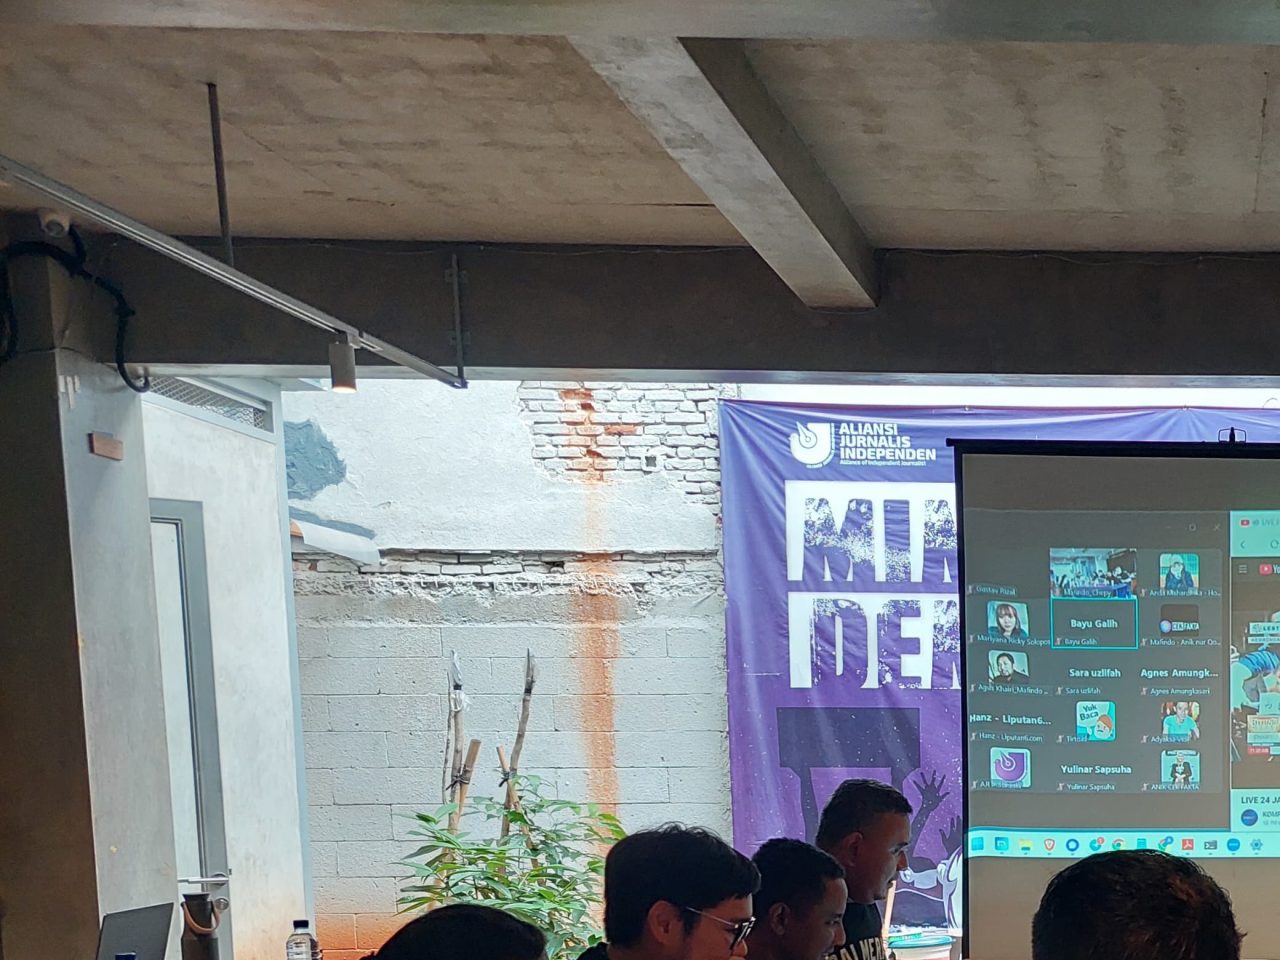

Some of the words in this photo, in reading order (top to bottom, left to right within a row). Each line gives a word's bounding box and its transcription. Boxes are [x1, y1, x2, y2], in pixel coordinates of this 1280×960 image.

[839, 423, 898, 435] ALIANSI
[839, 436, 911, 448] JURNALIS
[839, 447, 937, 461] INDEPENDEN
[1071, 619, 1093, 629] Bayu
[1095, 618, 1119, 628] Galih
[1064, 638, 1080, 646] Bayu
[1069, 667, 1089, 677] Sara
[1091, 667, 1121, 677] uzlifah
[1140, 668, 1169, 679] Agnes
[1066, 687, 1080, 695] Sara
[1150, 687, 1169, 696] Agnes
[1082, 703, 1098, 712] Yuk
[969, 714, 993, 723] Hanz
[1079, 710, 1099, 721] Baca
[1060, 764, 1093, 774] Yulinar
[1095, 764, 1132, 775] Sapsuha
[1240, 796, 1259, 804] LIVE
[1260, 796, 1270, 804] 24
